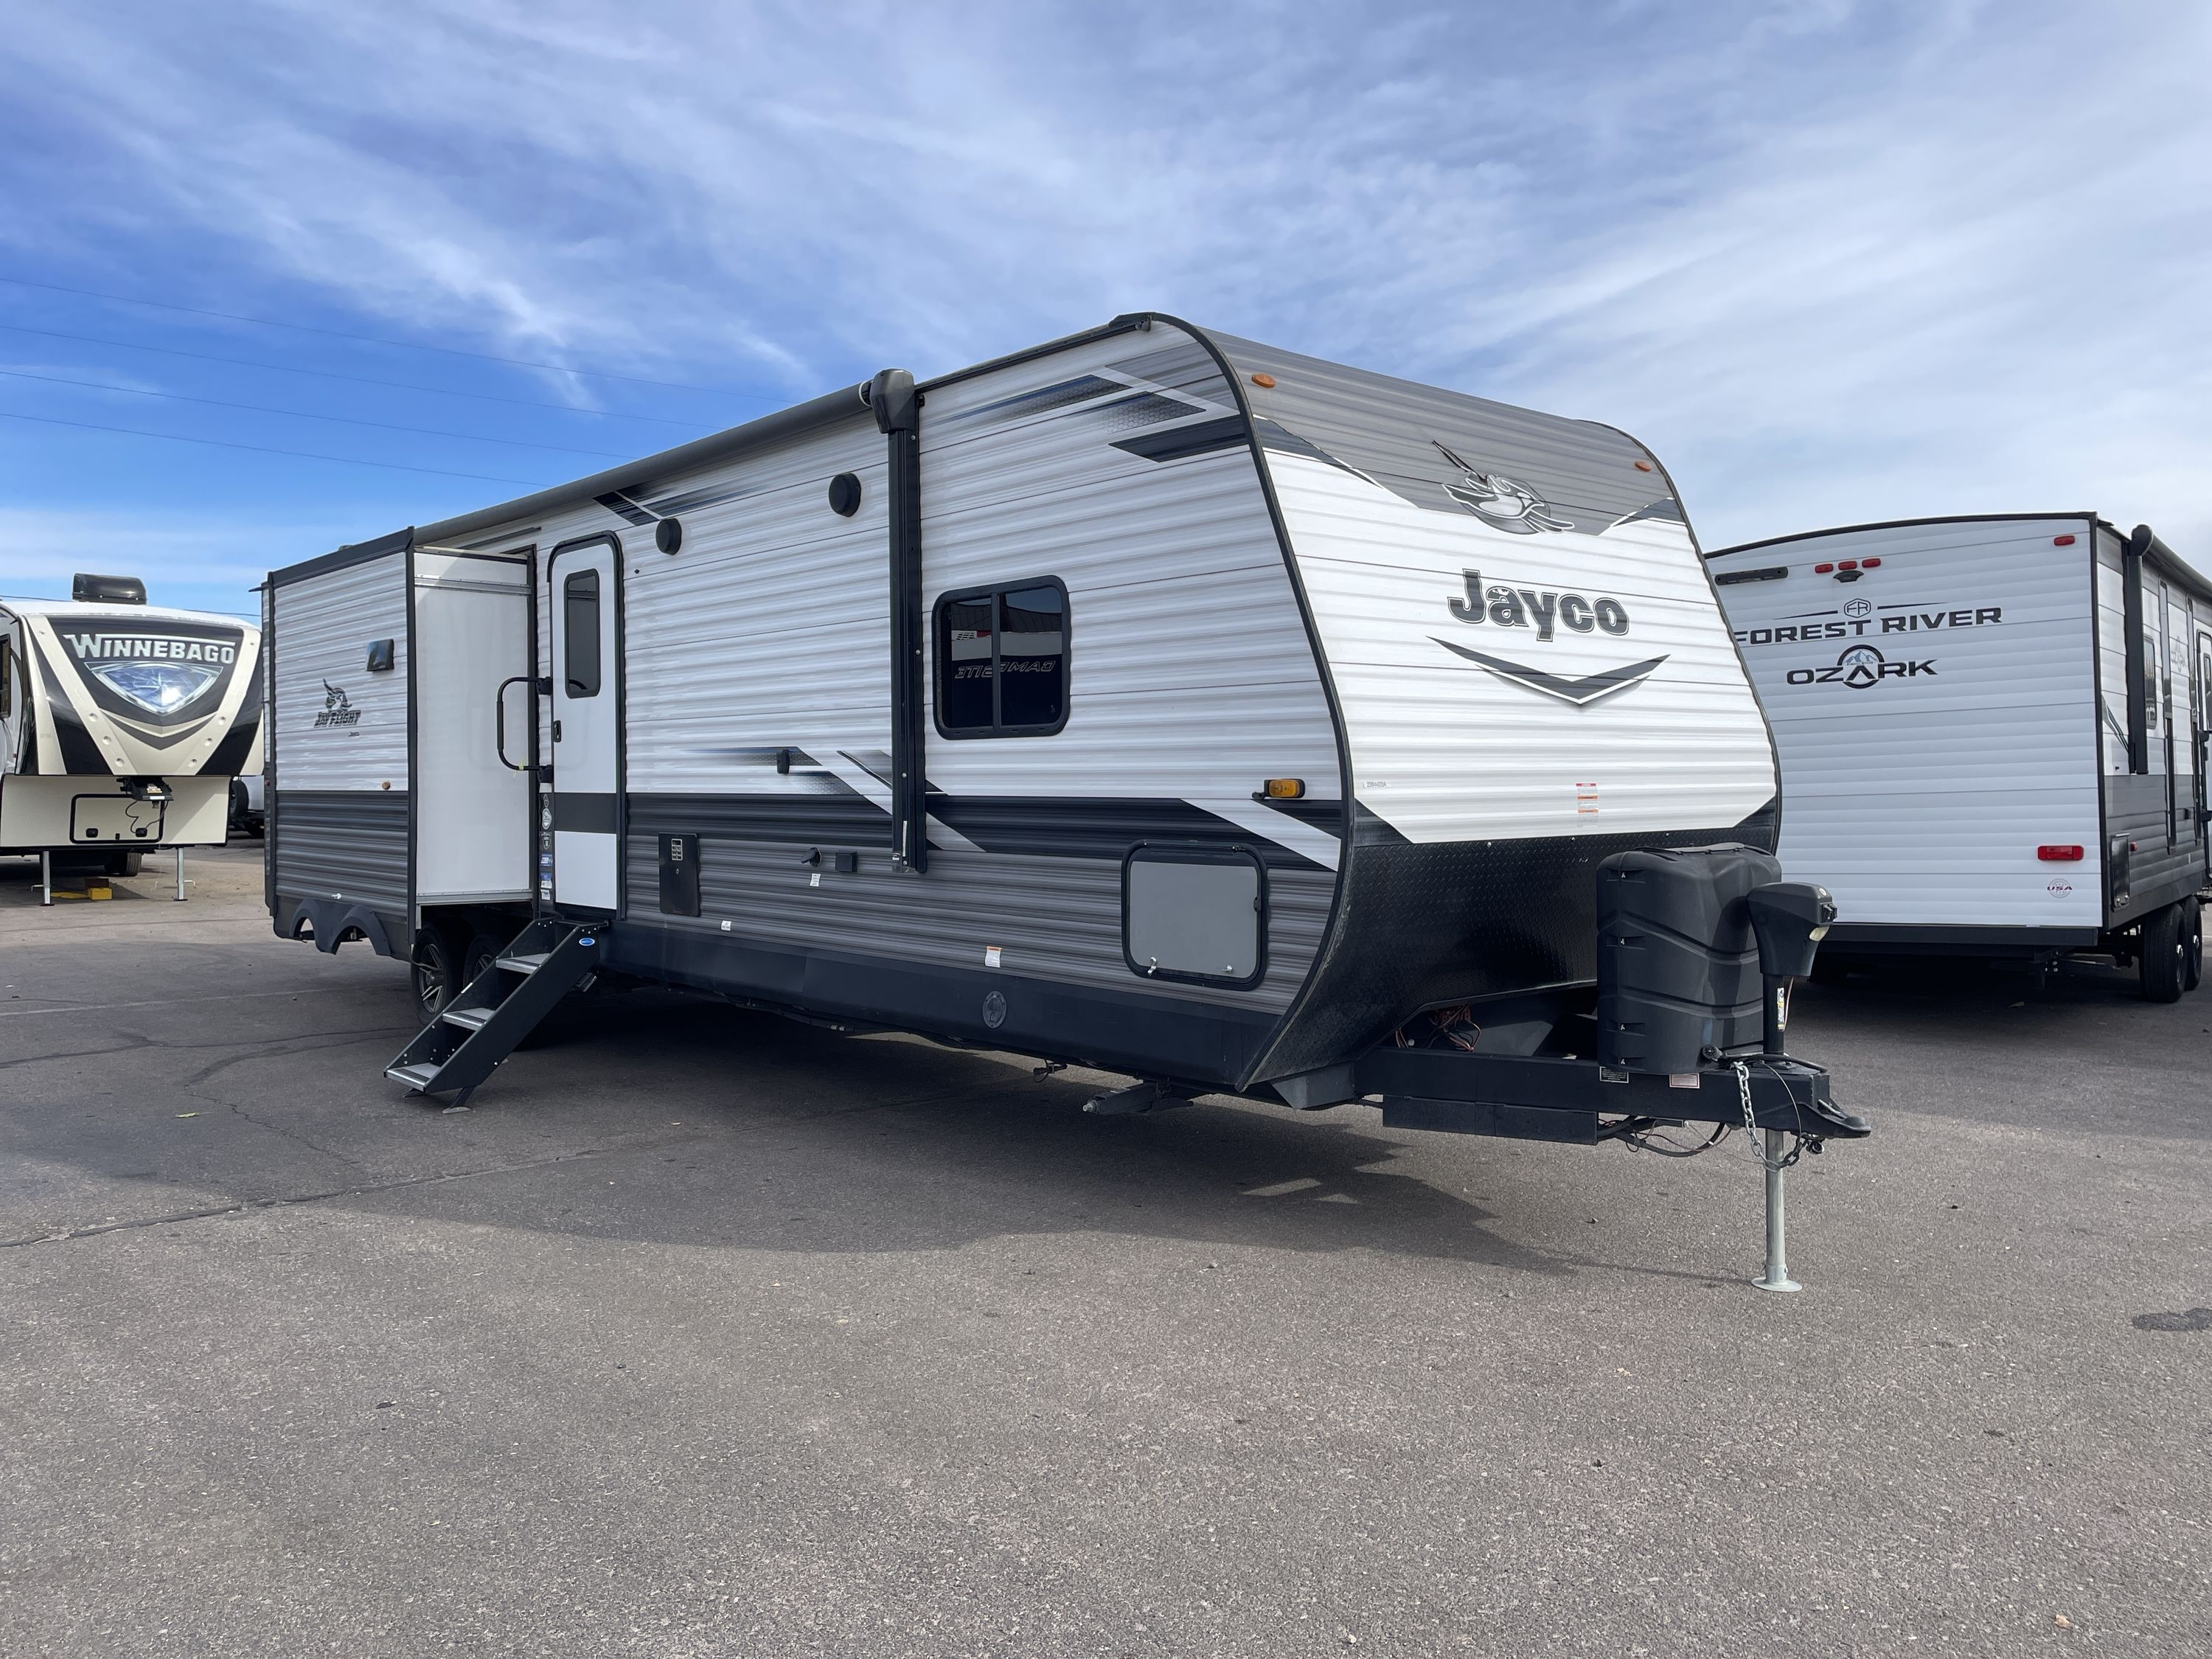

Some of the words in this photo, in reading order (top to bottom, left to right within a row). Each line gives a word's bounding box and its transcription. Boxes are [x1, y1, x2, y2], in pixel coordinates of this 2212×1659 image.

[1447, 568, 1630, 642] Jayco
[1880, 608, 2003, 633] RIVER
[63, 633, 235, 664] WINNEBAGO
[1787, 658, 1938, 685] OZARK
[328, 710, 361, 727] FLIGHT
